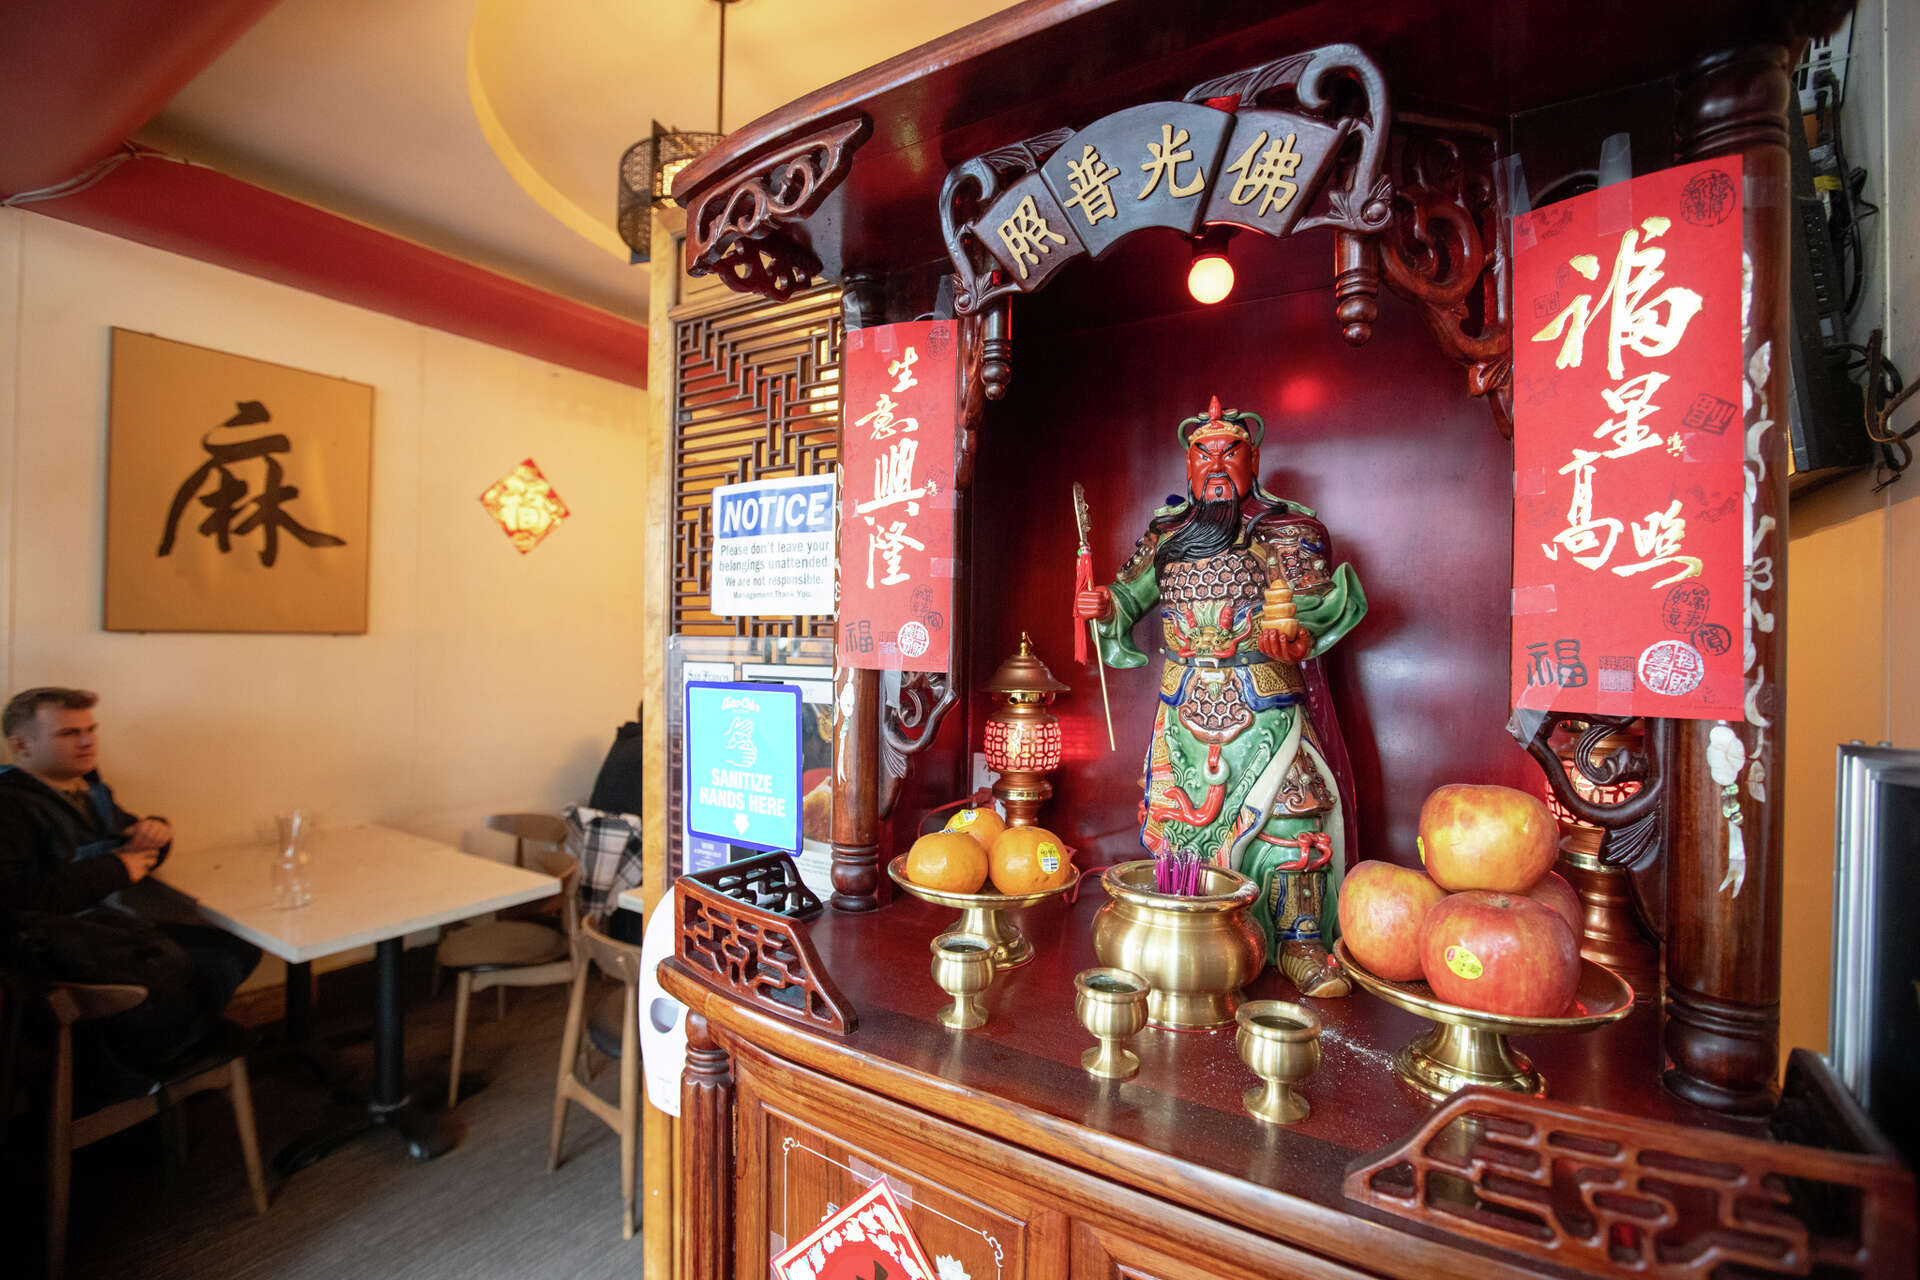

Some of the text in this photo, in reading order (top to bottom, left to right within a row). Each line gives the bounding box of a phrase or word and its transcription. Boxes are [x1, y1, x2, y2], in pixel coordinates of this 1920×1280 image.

[155, 400, 347, 568] 麻
[722, 491, 829, 532] NOTICE
[720, 540, 830, 556] Please don't leave your
[719, 559, 765, 573] belongings
[724, 572, 824, 588] We are not responsible.
[845, 619, 875, 654] 福
[1526, 638, 1588, 688] 福
[711, 767, 773, 794] SANITIZE
[700, 787, 786, 818] HANDS HERE
